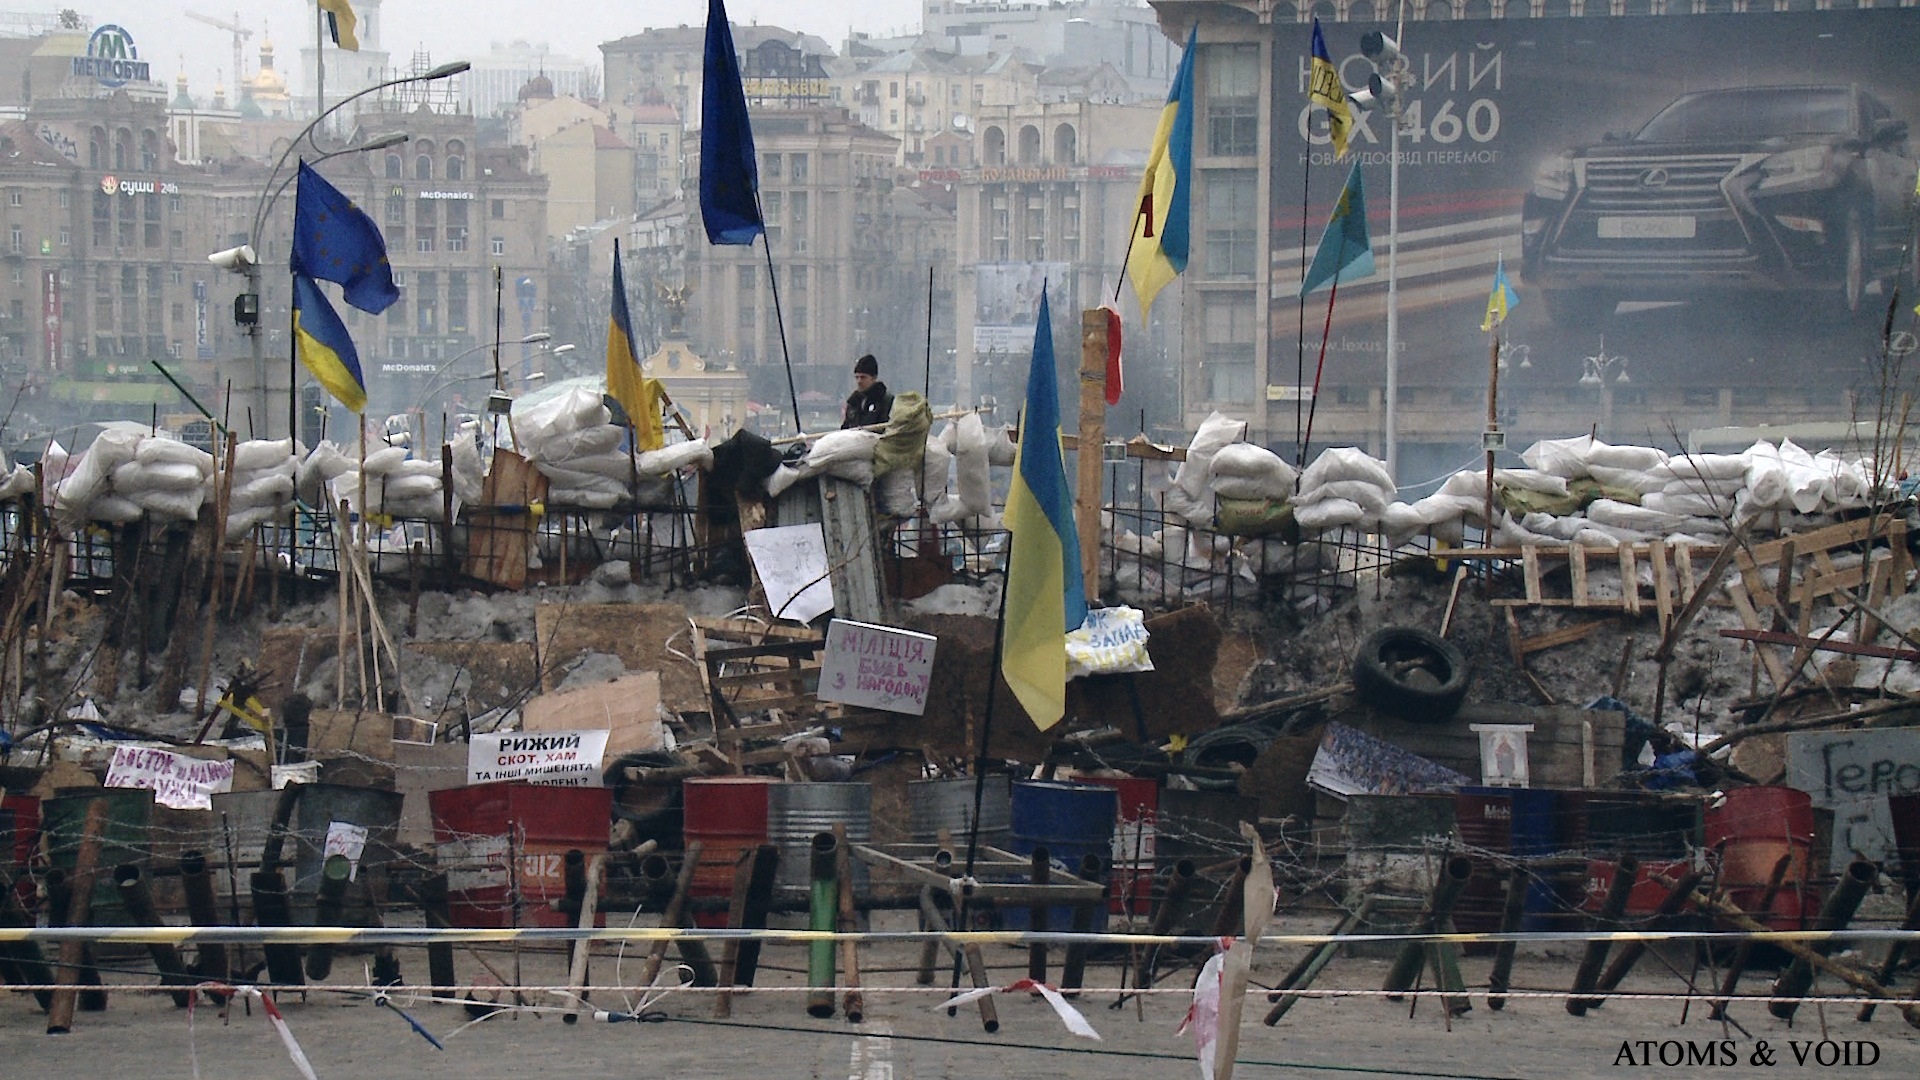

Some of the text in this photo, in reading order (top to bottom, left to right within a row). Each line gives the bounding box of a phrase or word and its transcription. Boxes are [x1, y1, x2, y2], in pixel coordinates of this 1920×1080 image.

[420, 190, 474, 200] McDonald's
[499, 733, 581, 752] РИЖИЙ
[498, 751, 577, 766] СКОТ, ХАМ
[476, 763, 593, 781] ТА ІНШІ МИШЕНЯТА
